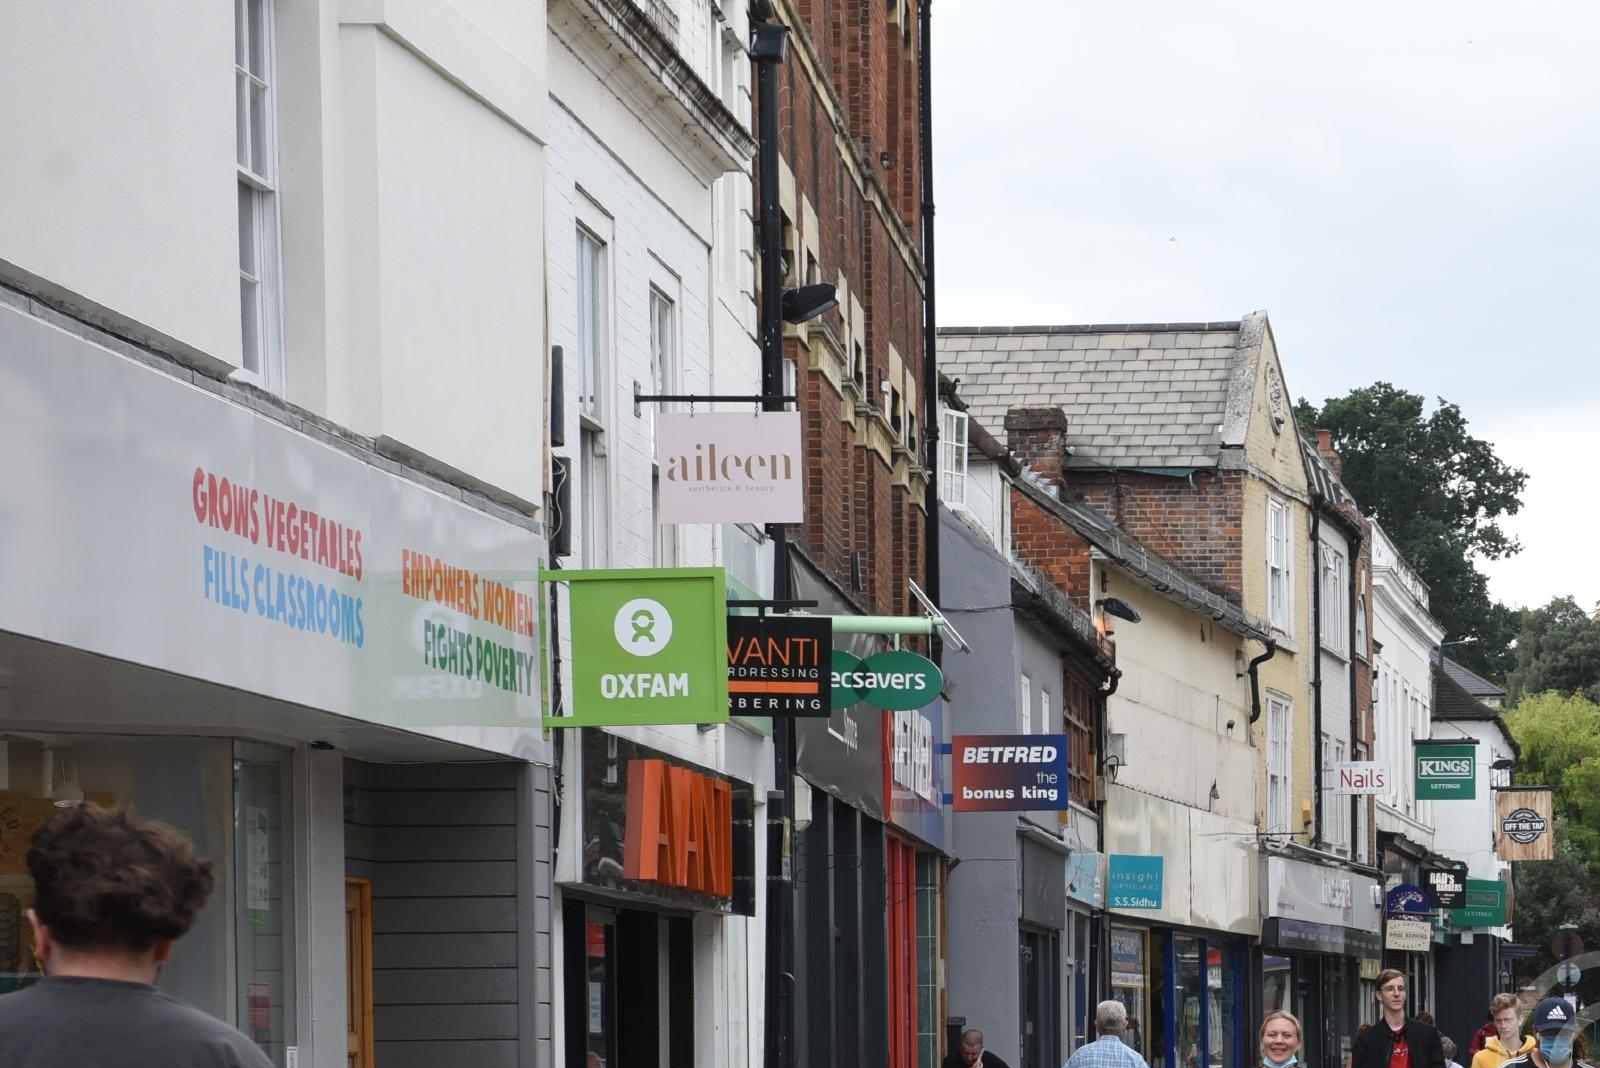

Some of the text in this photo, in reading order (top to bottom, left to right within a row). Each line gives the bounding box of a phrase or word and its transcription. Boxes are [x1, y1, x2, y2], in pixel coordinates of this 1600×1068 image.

[667, 443, 791, 481] aileen
[745, 484, 774, 493] beauty
[193, 467, 363, 582] GROWS VEGETABLES
[203, 544, 364, 649] FILLS CLASSROOMS
[402, 549, 534, 637] EMPOWERS WOMEN
[423, 619, 534, 697] FIGHTS POVERTY
[727, 637, 818, 665] VANTI
[728, 667, 818, 678] RDRESSING
[831, 670, 926, 690] ecsavers
[601, 672, 689, 698] OXFAM
[963, 746, 1057, 763] BETFRED
[1421, 760, 1470, 776] KINGS
[1037, 772, 1057, 784] the
[1340, 768, 1384, 788] Nails
[963, 786, 1058, 801] bonus king
[1504, 821, 1544, 831] OFF THE TAP
[1112, 871, 1159, 882] insight
[1430, 872, 1455, 885] RAD'S
[1114, 897, 1157, 907] S.S.Sidhu
